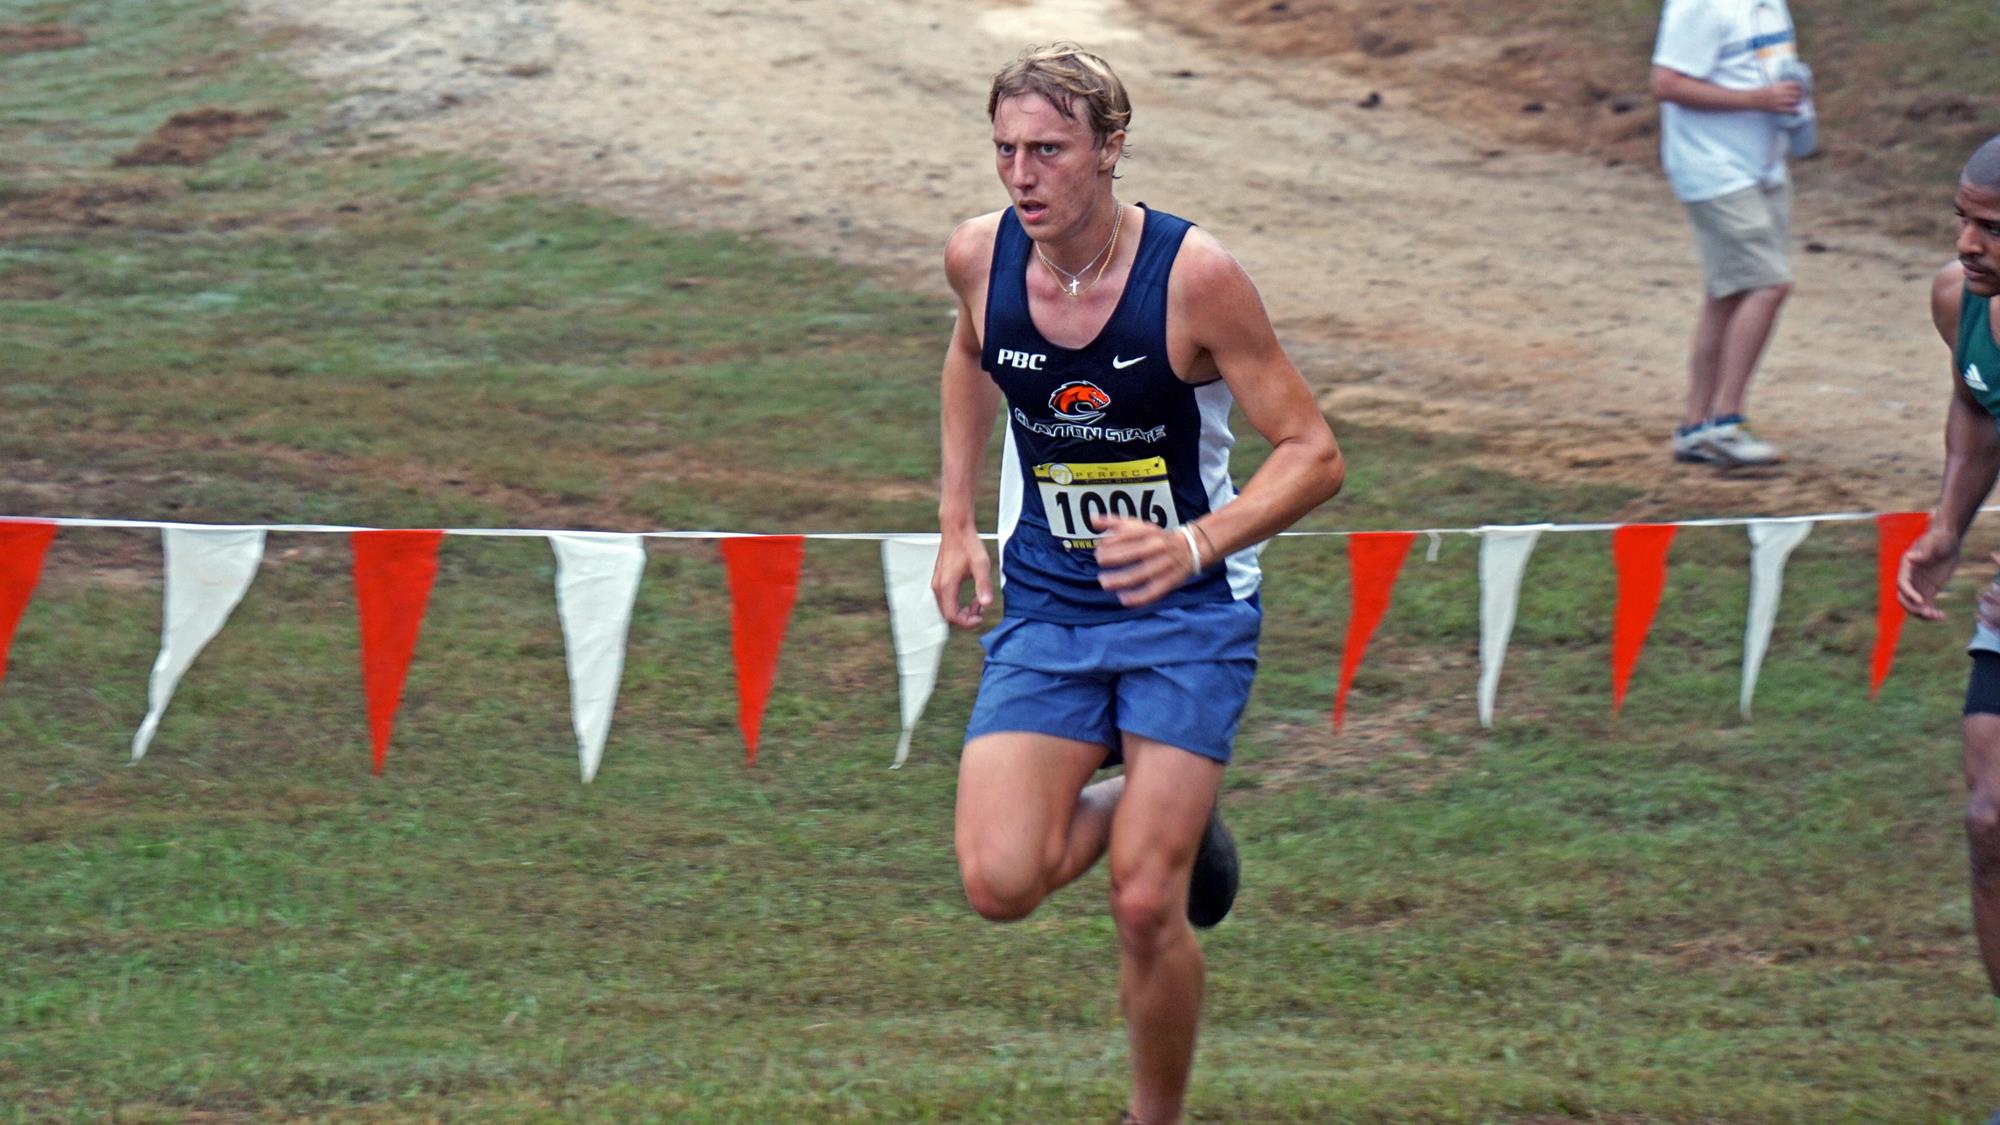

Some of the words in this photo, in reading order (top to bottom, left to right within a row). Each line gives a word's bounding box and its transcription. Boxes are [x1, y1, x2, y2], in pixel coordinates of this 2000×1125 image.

[997, 349, 1047, 371] PBC
[1014, 407, 1102, 441] CLAYTON
[1105, 424, 1167, 443] STATE
[1075, 468, 1152, 479] PERFECT
[1055, 489, 1168, 535] 1006
